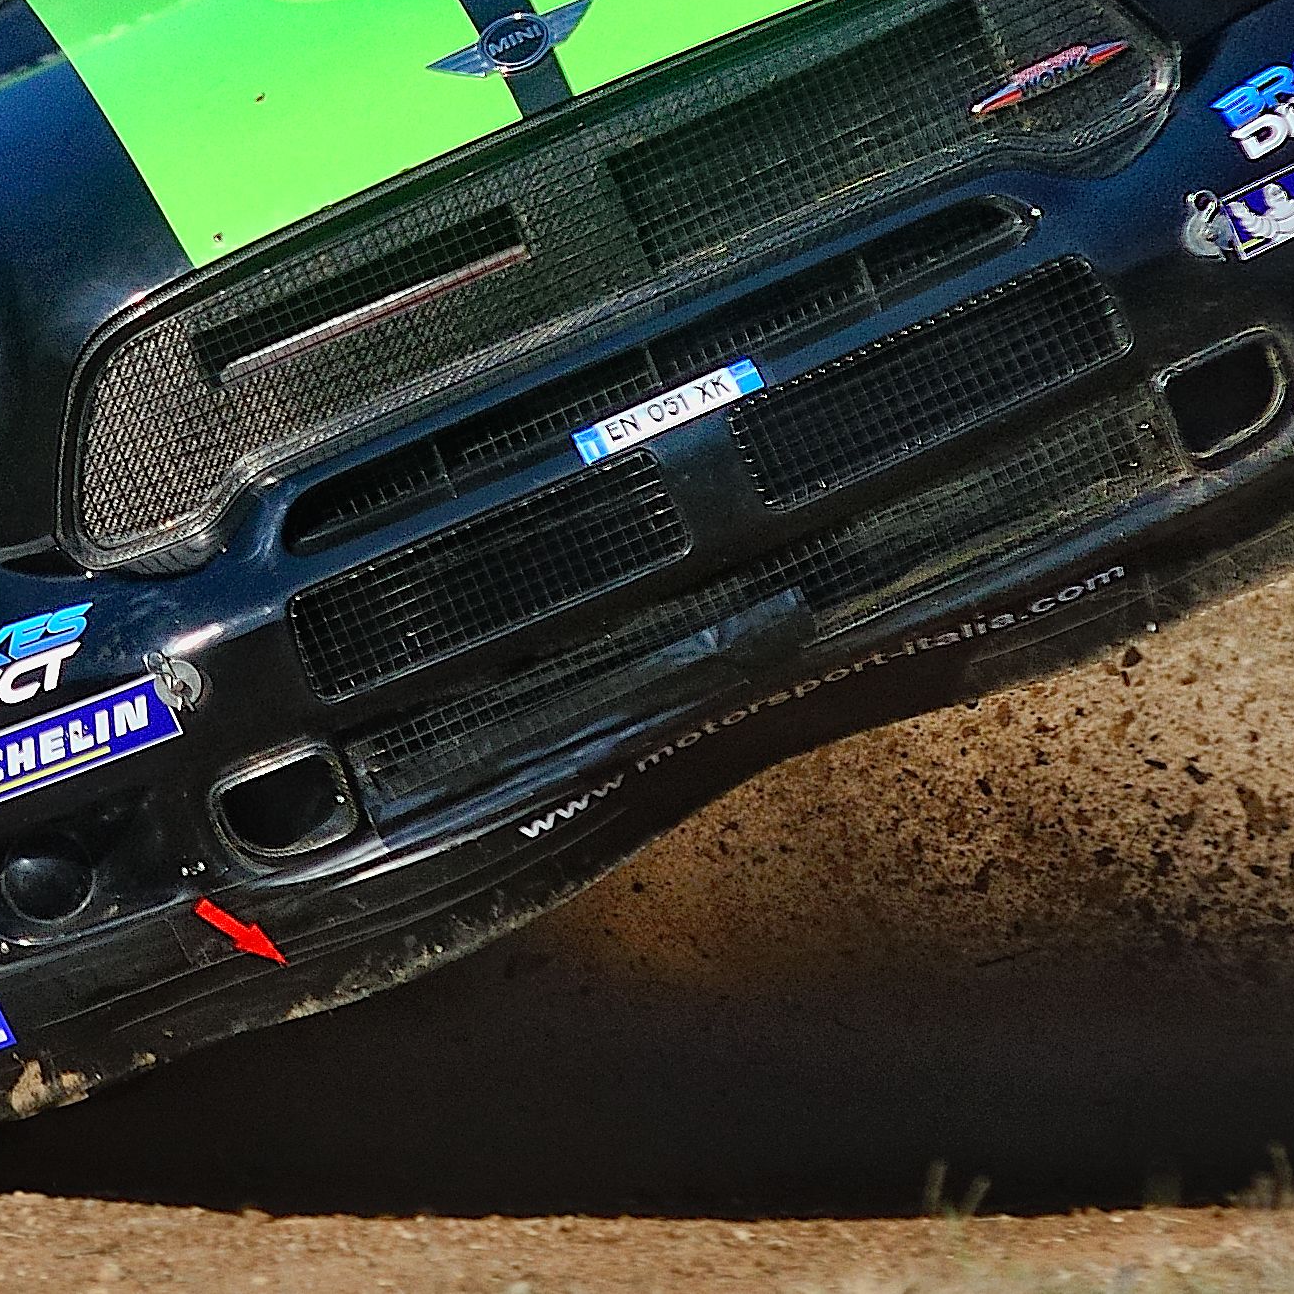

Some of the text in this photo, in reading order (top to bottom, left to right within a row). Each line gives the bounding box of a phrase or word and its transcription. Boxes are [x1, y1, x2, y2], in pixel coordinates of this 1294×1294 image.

[488, 23, 544, 56] MINI
[605, 414, 642, 442] EN
[646, 393, 691, 423] 051
[693, 374, 732, 404] XK
